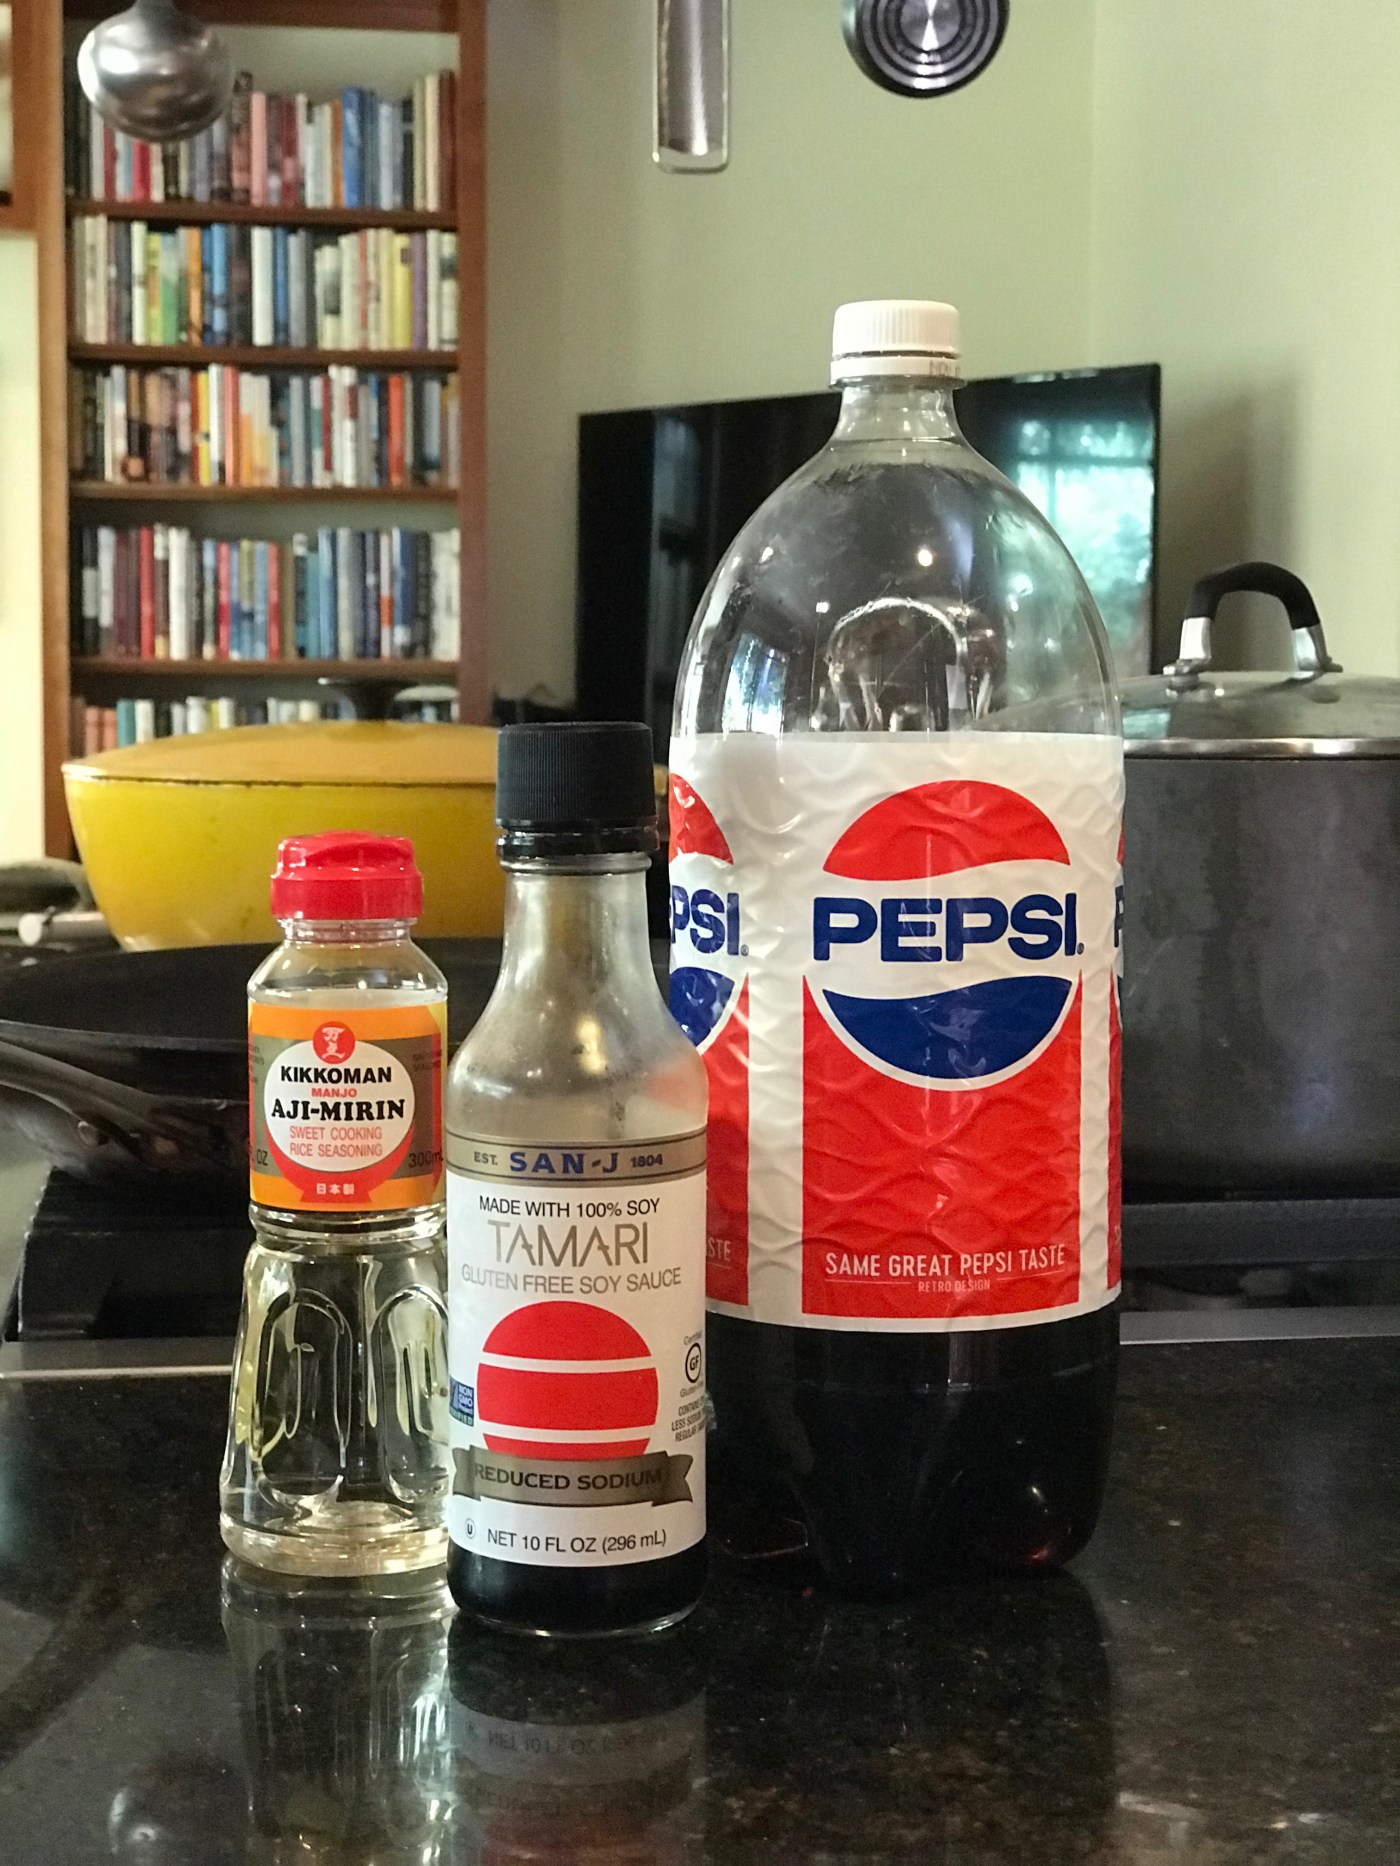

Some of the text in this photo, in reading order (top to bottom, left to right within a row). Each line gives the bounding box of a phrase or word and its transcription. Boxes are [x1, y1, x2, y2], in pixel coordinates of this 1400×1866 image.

[672, 885, 739, 955] PSI
[813, 893, 1077, 962] PEPSI
[281, 1066, 391, 1084] KIKKOMAN
[311, 1087, 357, 1098] MANJO
[271, 1098, 405, 1121] AJI-MIRIN
[289, 1126, 383, 1140] SWEET COOKING
[289, 1143, 383, 1158] RICE SEASONING
[474, 1151, 498, 1165] EST.
[631, 1154, 663, 1168] 1804
[479, 1195, 660, 1217] MADE WITH 100% SOY
[487, 1219, 648, 1267] TAMARI
[708, 1237, 731, 1261] STE
[825, 1243, 1065, 1277] SAME GREAT PEPSI TASTE
[461, 1263, 682, 1294] GLUTEN FREE SOY SAUCE
[918, 1279, 991, 1293] RETRO DESIGN
[690, 1355, 699, 1370] GF
[474, 1463, 662, 1490] REDUCED SODIUM
[487, 1528, 667, 1555] NET 10 FL OZ (296 mL)
